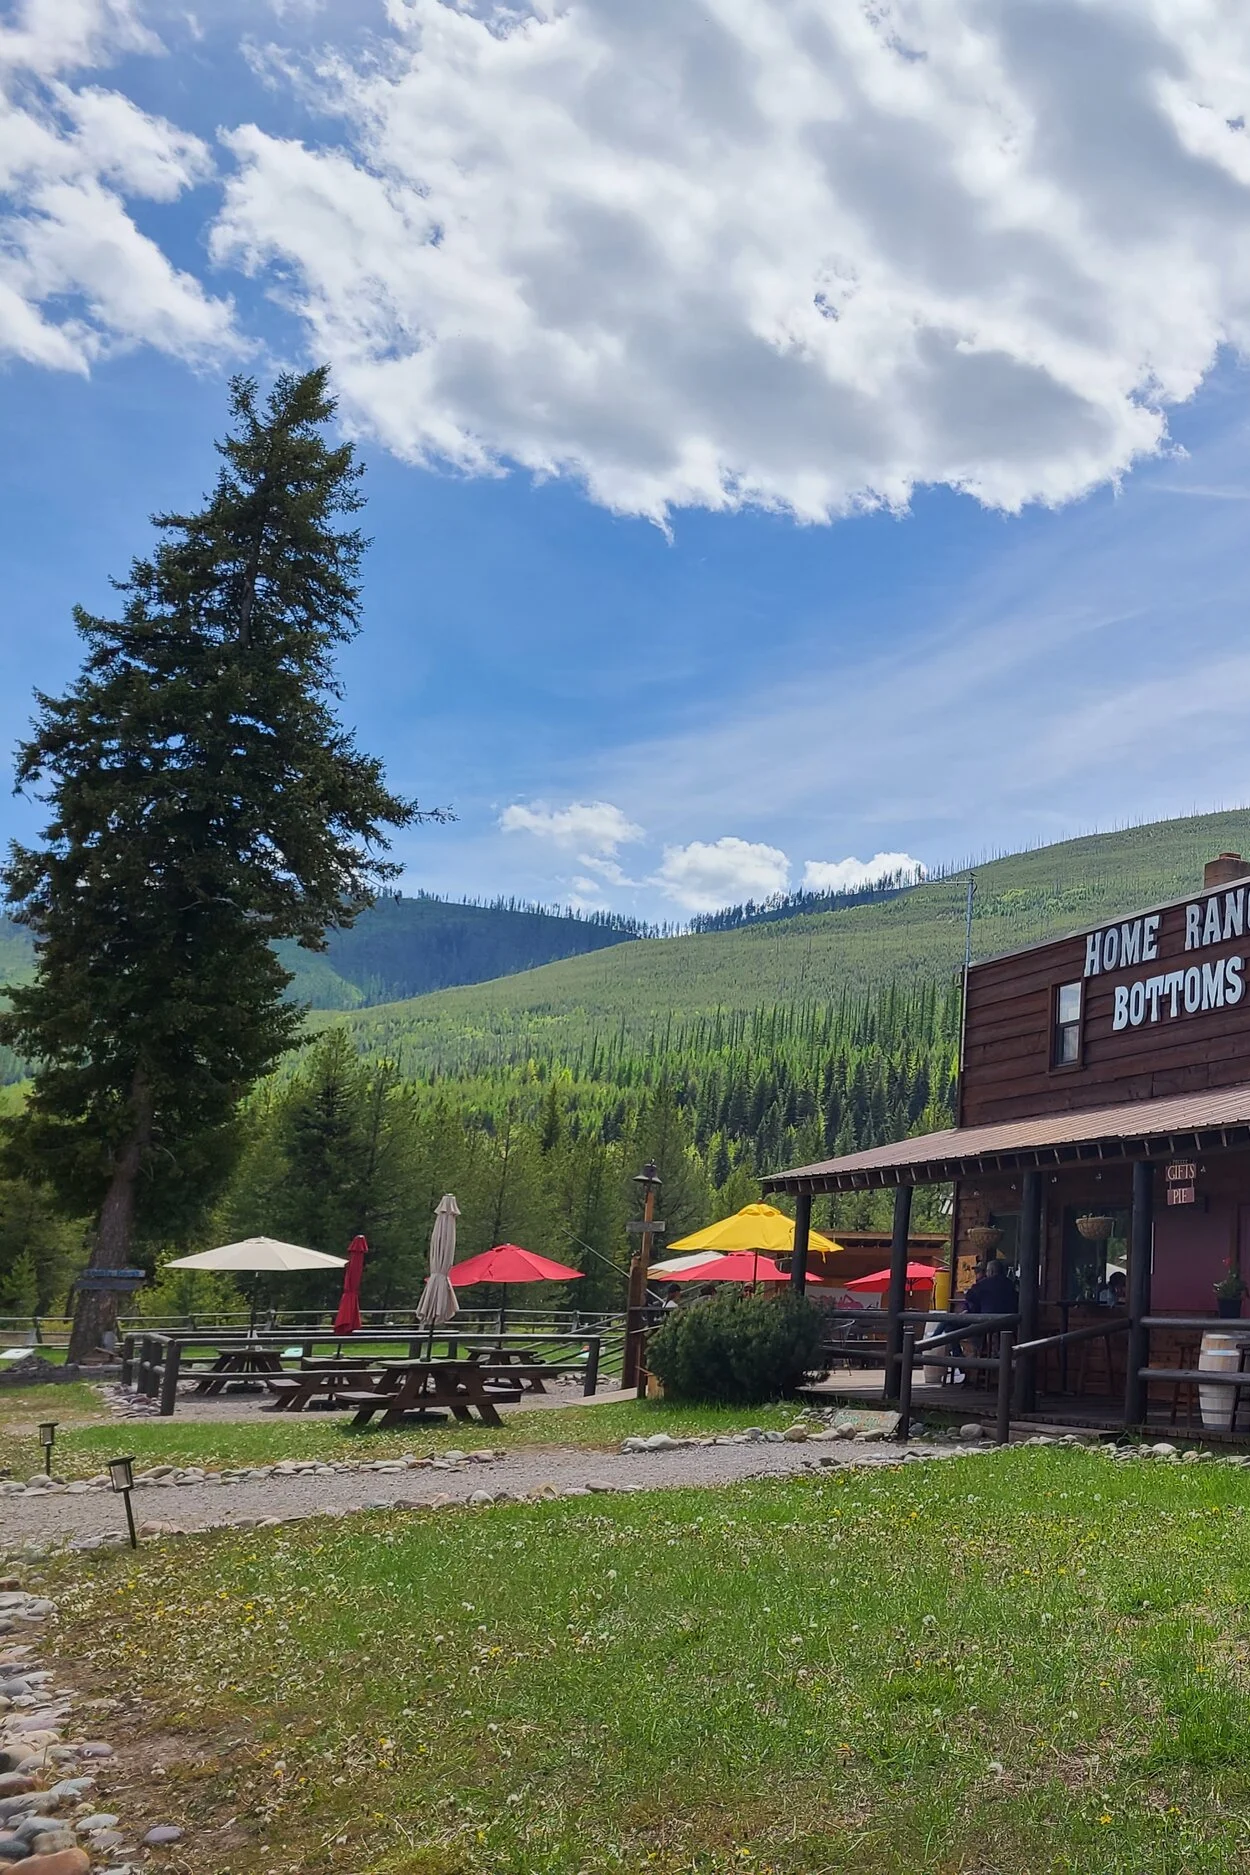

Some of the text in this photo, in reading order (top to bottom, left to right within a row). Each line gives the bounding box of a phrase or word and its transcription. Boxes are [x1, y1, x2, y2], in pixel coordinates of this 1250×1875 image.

[1084, 914, 1161, 977] HOME
[1112, 955, 1245, 1031] BOTTOMS
[1167, 1163, 1195, 1181] GIFTS
[1173, 1188, 1188, 1205] PIE
